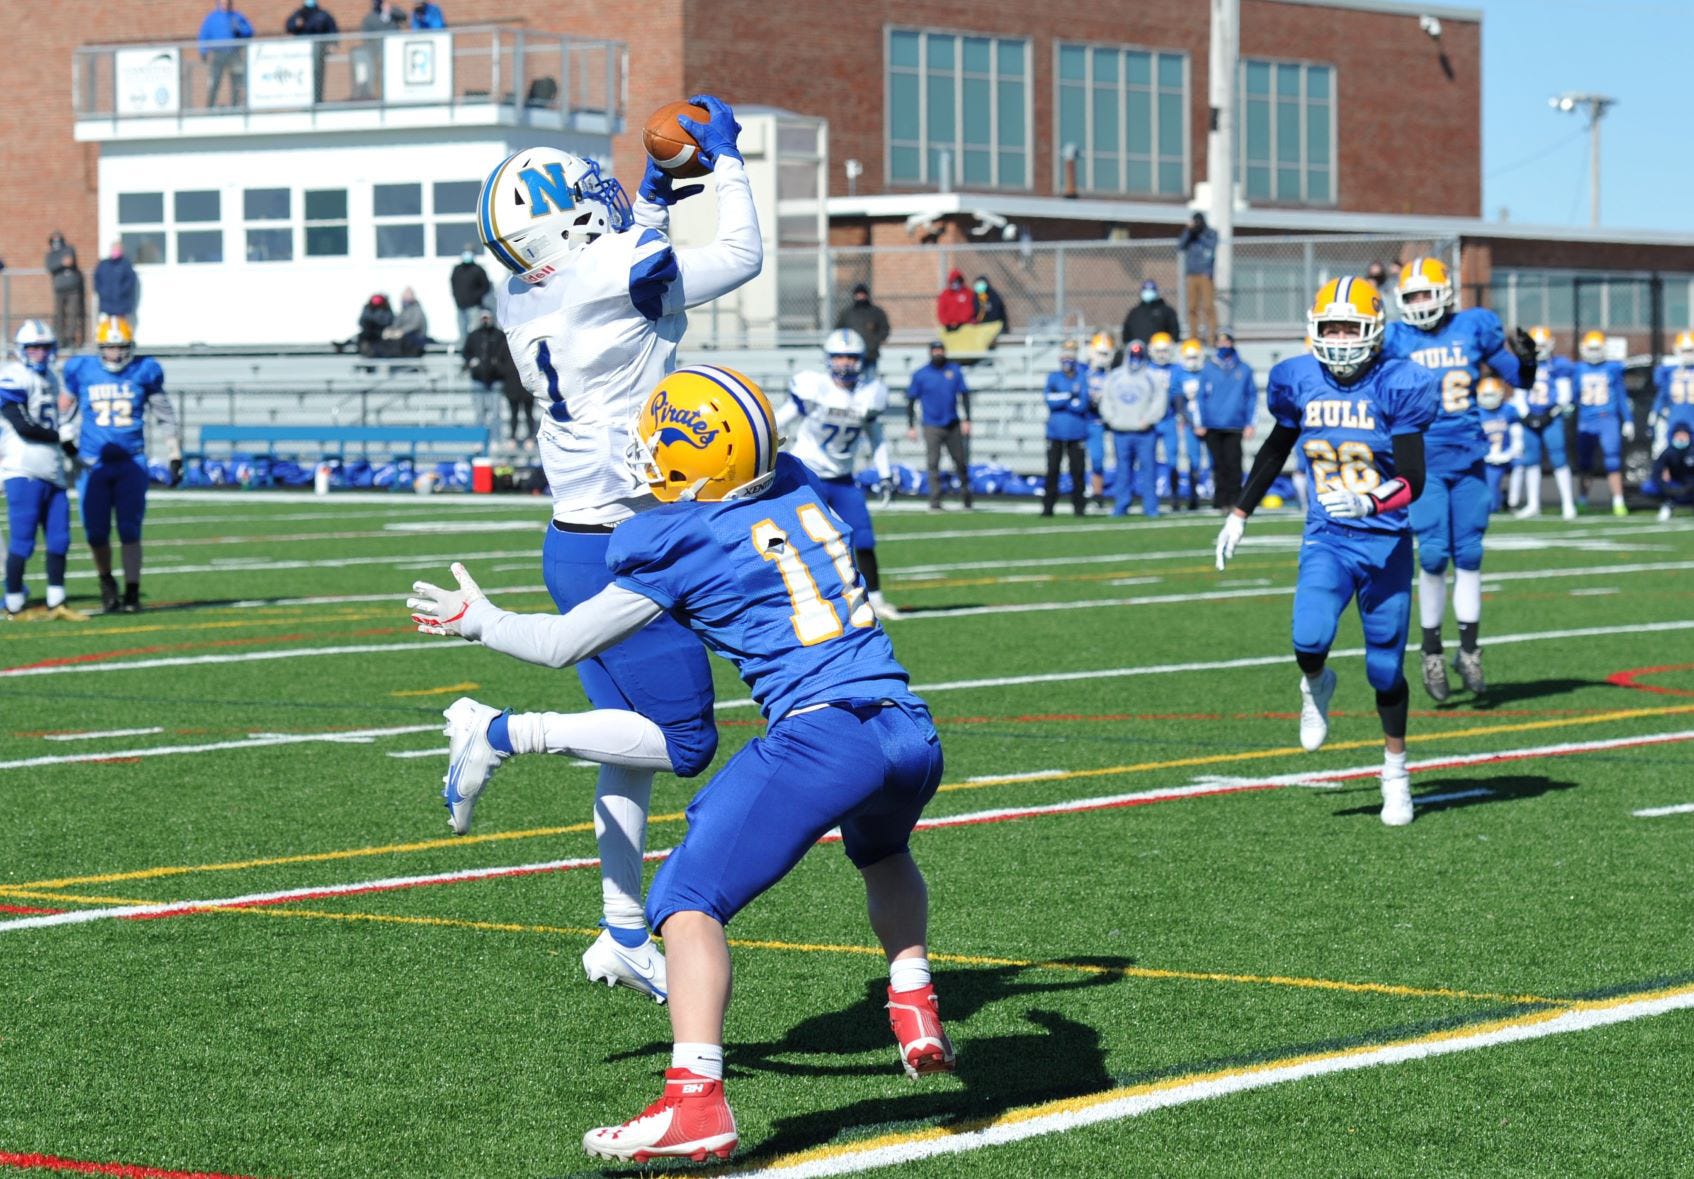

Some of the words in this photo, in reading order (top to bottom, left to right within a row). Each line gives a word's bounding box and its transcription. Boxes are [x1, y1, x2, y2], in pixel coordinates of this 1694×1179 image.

[517, 162, 576, 218] N
[537, 340, 573, 422] 1
[651, 391, 720, 449] Pirates
[820, 424, 862, 453] 77
[1304, 400, 1375, 430] HULL
[751, 503, 876, 646] 11
